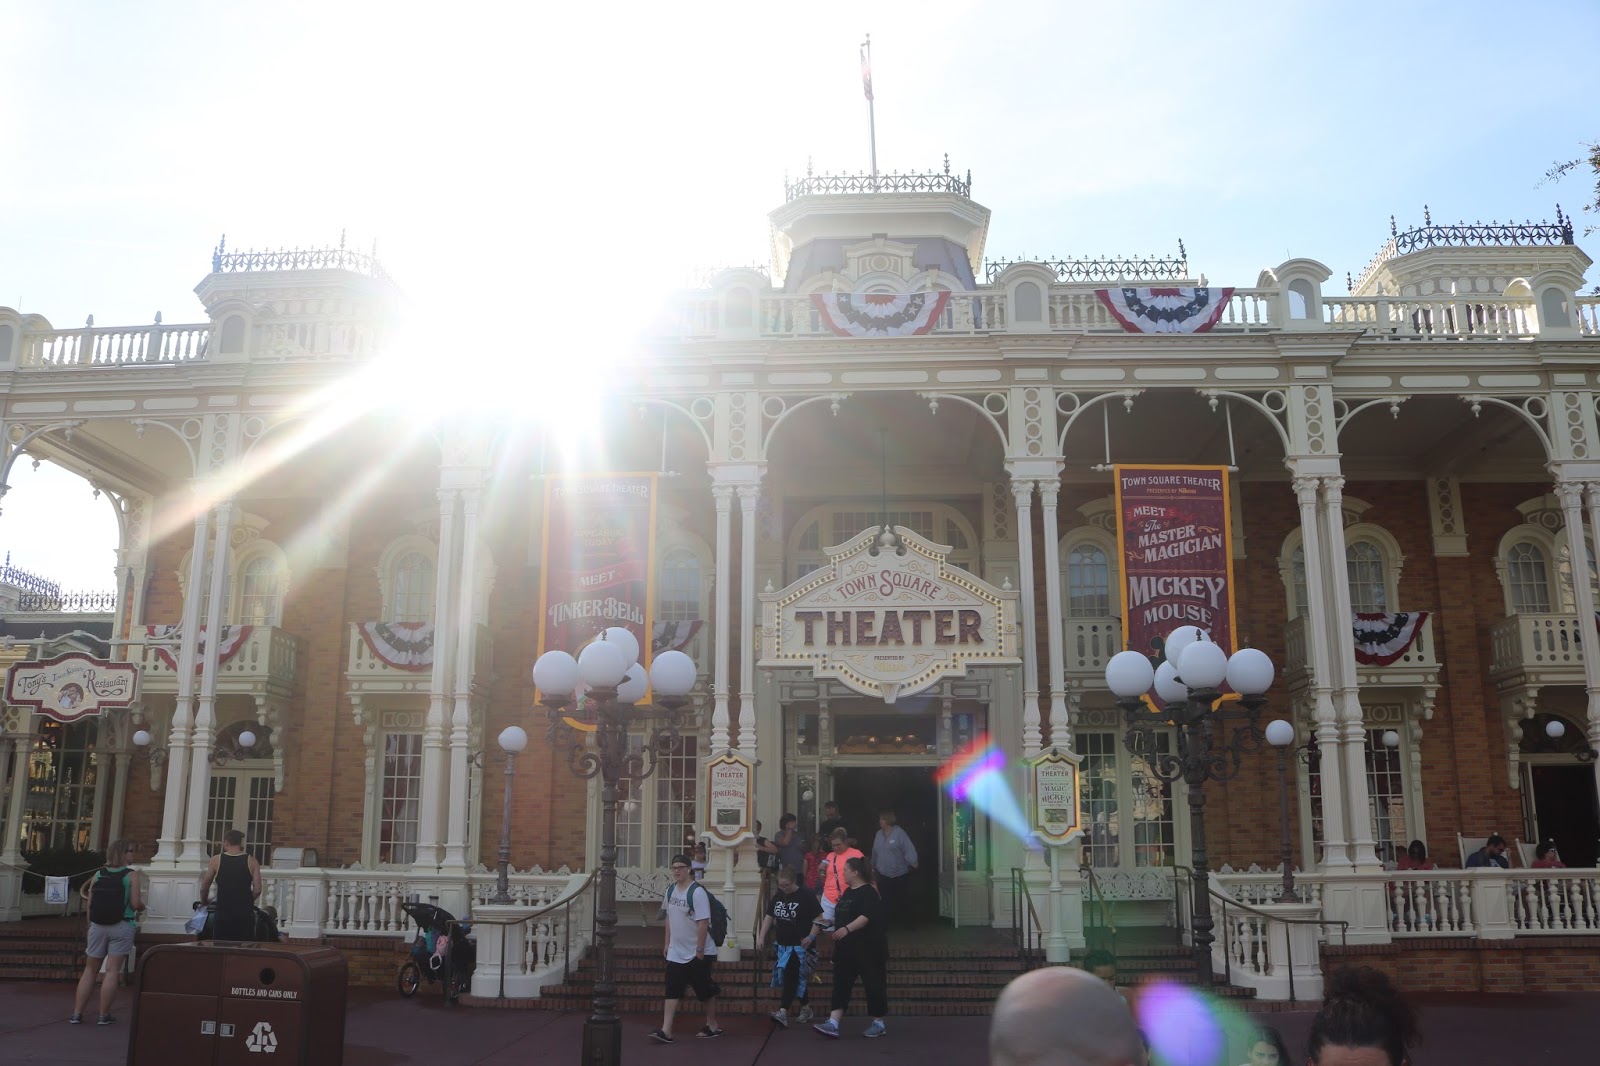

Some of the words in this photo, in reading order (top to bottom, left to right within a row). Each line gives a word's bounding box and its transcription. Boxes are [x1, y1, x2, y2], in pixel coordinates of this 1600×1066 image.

[611, 484, 648, 498] THEATER
[1122, 477, 1146, 490] TOWN
[1148, 476, 1180, 485] SQUARE
[1182, 476, 1220, 491] THEATER
[1133, 505, 1166, 517] MEET
[1144, 519, 1161, 532] The
[1138, 524, 1195, 548] MASTER
[1143, 533, 1222, 563] MAGICIAN
[579, 570, 616, 586] MEET
[836, 574, 877, 599] TOWN
[879, 569, 942, 598] SQUARE
[1129, 576, 1225, 610] MICKEY
[548, 600, 602, 627] TINKER
[602, 597, 644, 625] BELL
[1143, 604, 1213, 626] MOUSE
[794, 610, 984, 646] THEATER
[18, 673, 54, 695] Tony's
[83, 669, 128, 697] Restaurant
[712, 789, 732, 799] TINKER
[731, 789, 746, 799] BELL
[1041, 794, 1071, 804] MICKEY
[231, 987, 256, 997] BOTTLES
[256, 988, 268, 998] AND
[268, 989, 282, 999] CANS
[282, 990, 298, 999] ONLY
